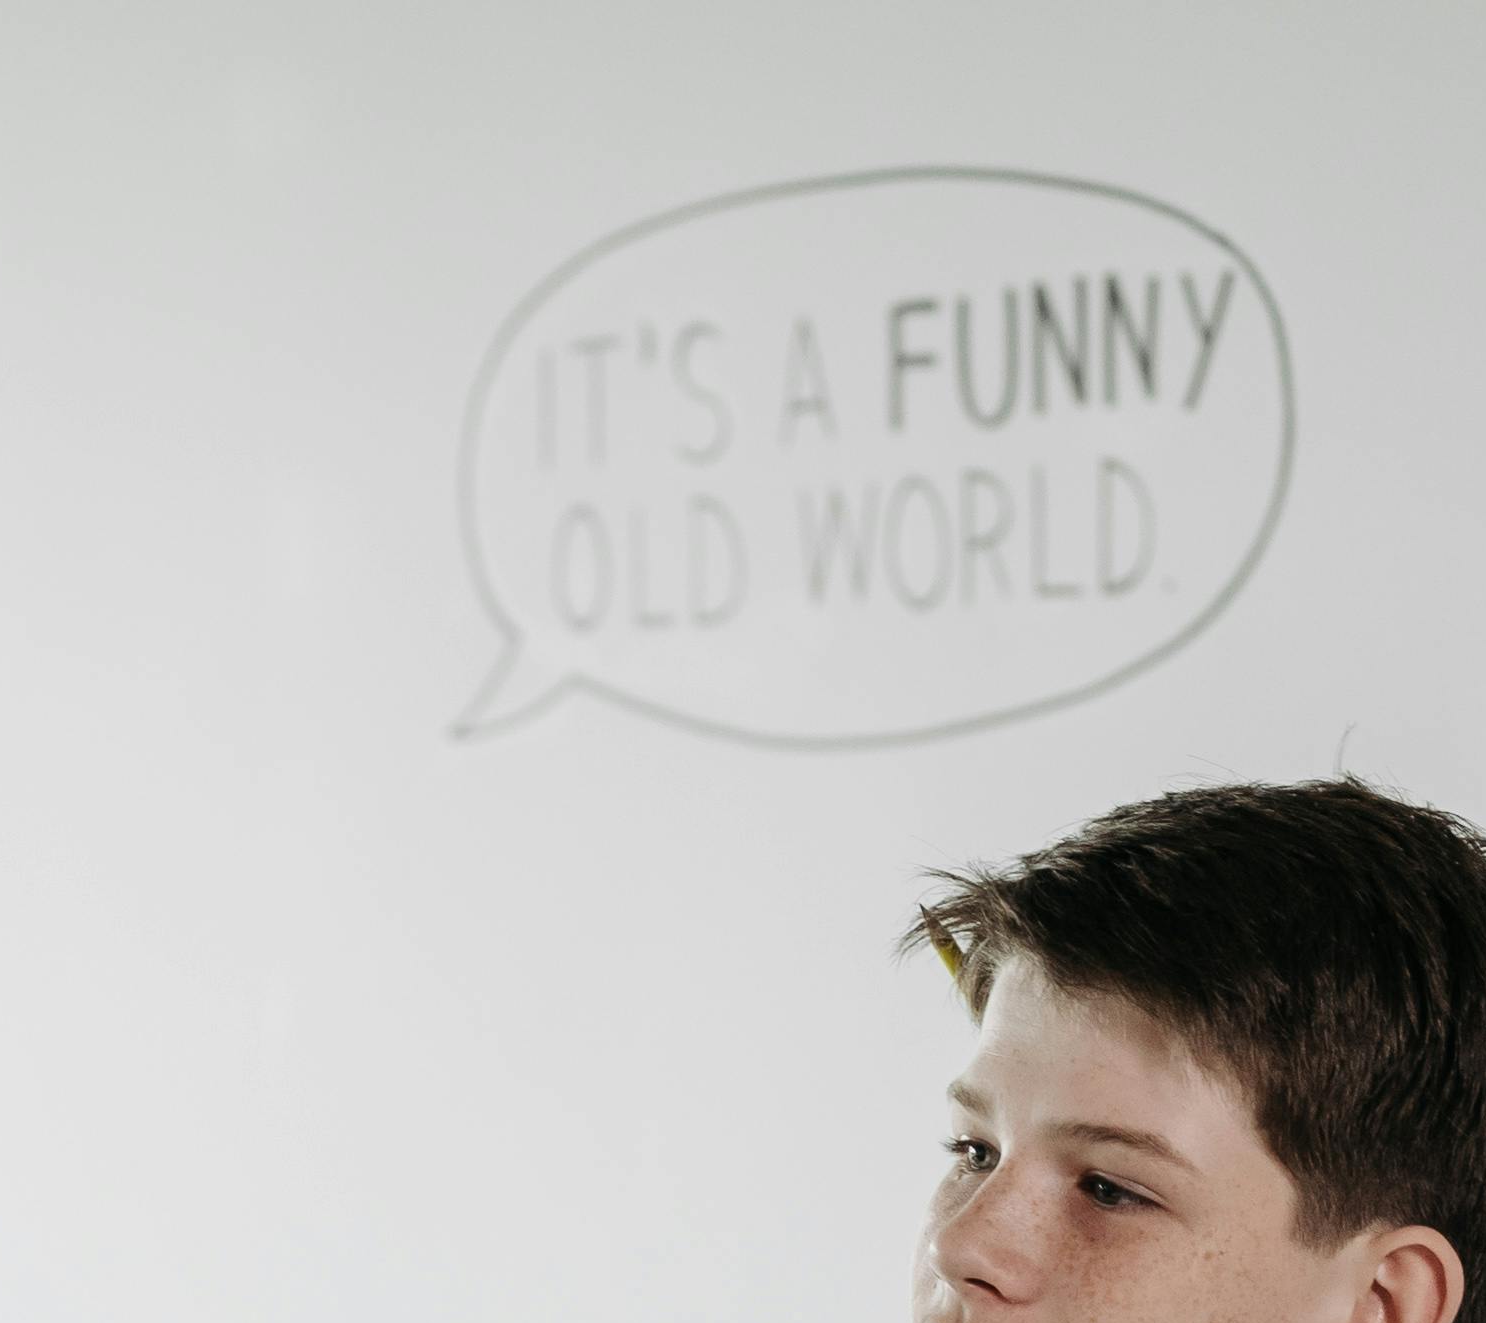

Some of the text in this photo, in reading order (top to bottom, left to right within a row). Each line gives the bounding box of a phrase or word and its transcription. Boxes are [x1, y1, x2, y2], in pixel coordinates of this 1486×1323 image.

[537, 268, 1238, 470] IT'S A FUNNY
[550, 453, 1180, 636] OLD WORLD.
